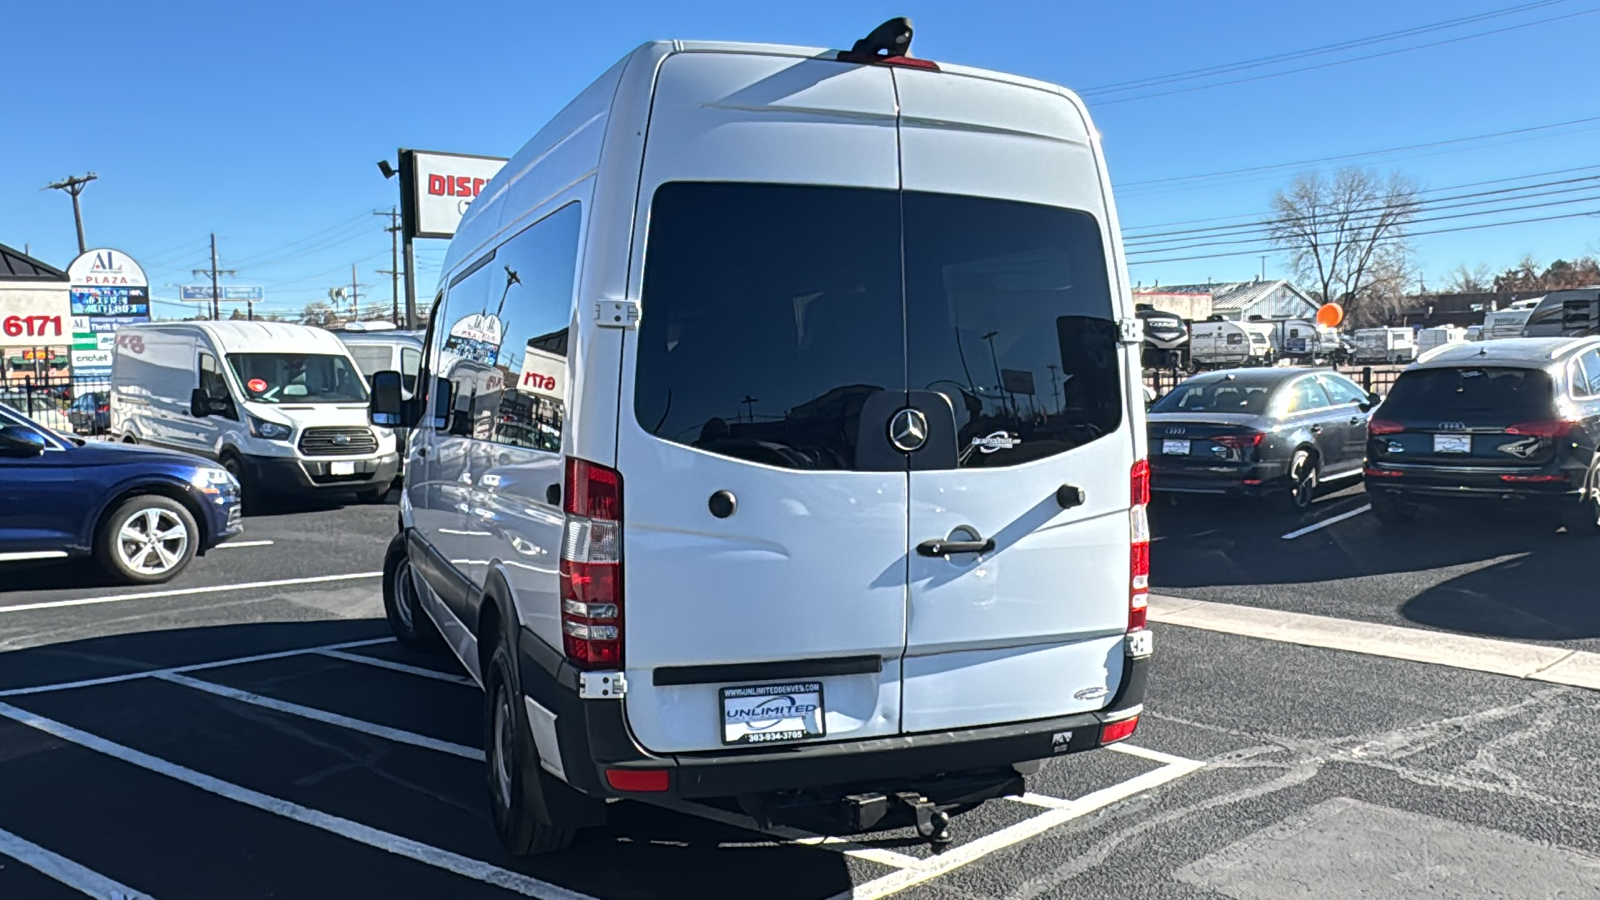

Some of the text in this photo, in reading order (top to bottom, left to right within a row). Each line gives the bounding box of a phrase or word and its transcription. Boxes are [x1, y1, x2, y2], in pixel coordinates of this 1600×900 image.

[428, 173, 492, 197] DISC
[85, 275, 129, 285] PLAZA
[3, 315, 63, 337] 6171
[91, 322, 112, 332] Thrift
[76, 353, 109, 363] cricket
[727, 704, 817, 718] UNLIMITED
[748, 731, 803, 743] 303-934-3705
